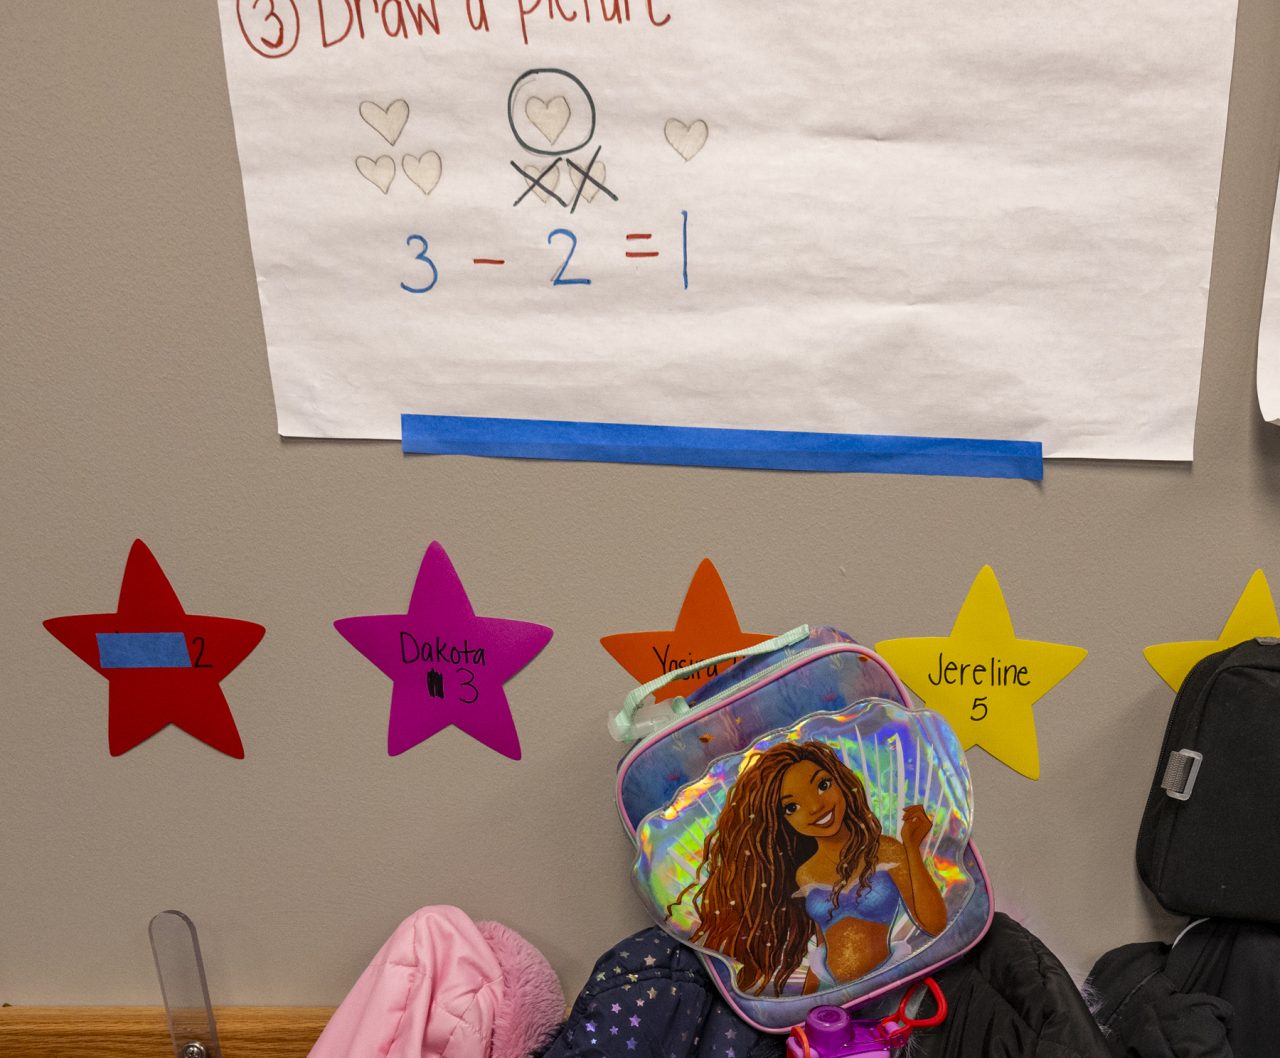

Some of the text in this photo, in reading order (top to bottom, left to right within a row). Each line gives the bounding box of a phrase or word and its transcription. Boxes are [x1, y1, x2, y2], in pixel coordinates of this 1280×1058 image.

[316, 0, 440, 48] Draw
[465, 0, 490, 32] a
[400, 234, 438, 293] 3
[547, 229, 592, 286] 2
[192, 636, 214, 669] 2
[400, 631, 486, 667] Dakota
[455, 667, 480, 705] 3
[928, 652, 1031, 686] Jereline
[970, 696, 988, 722] 5
